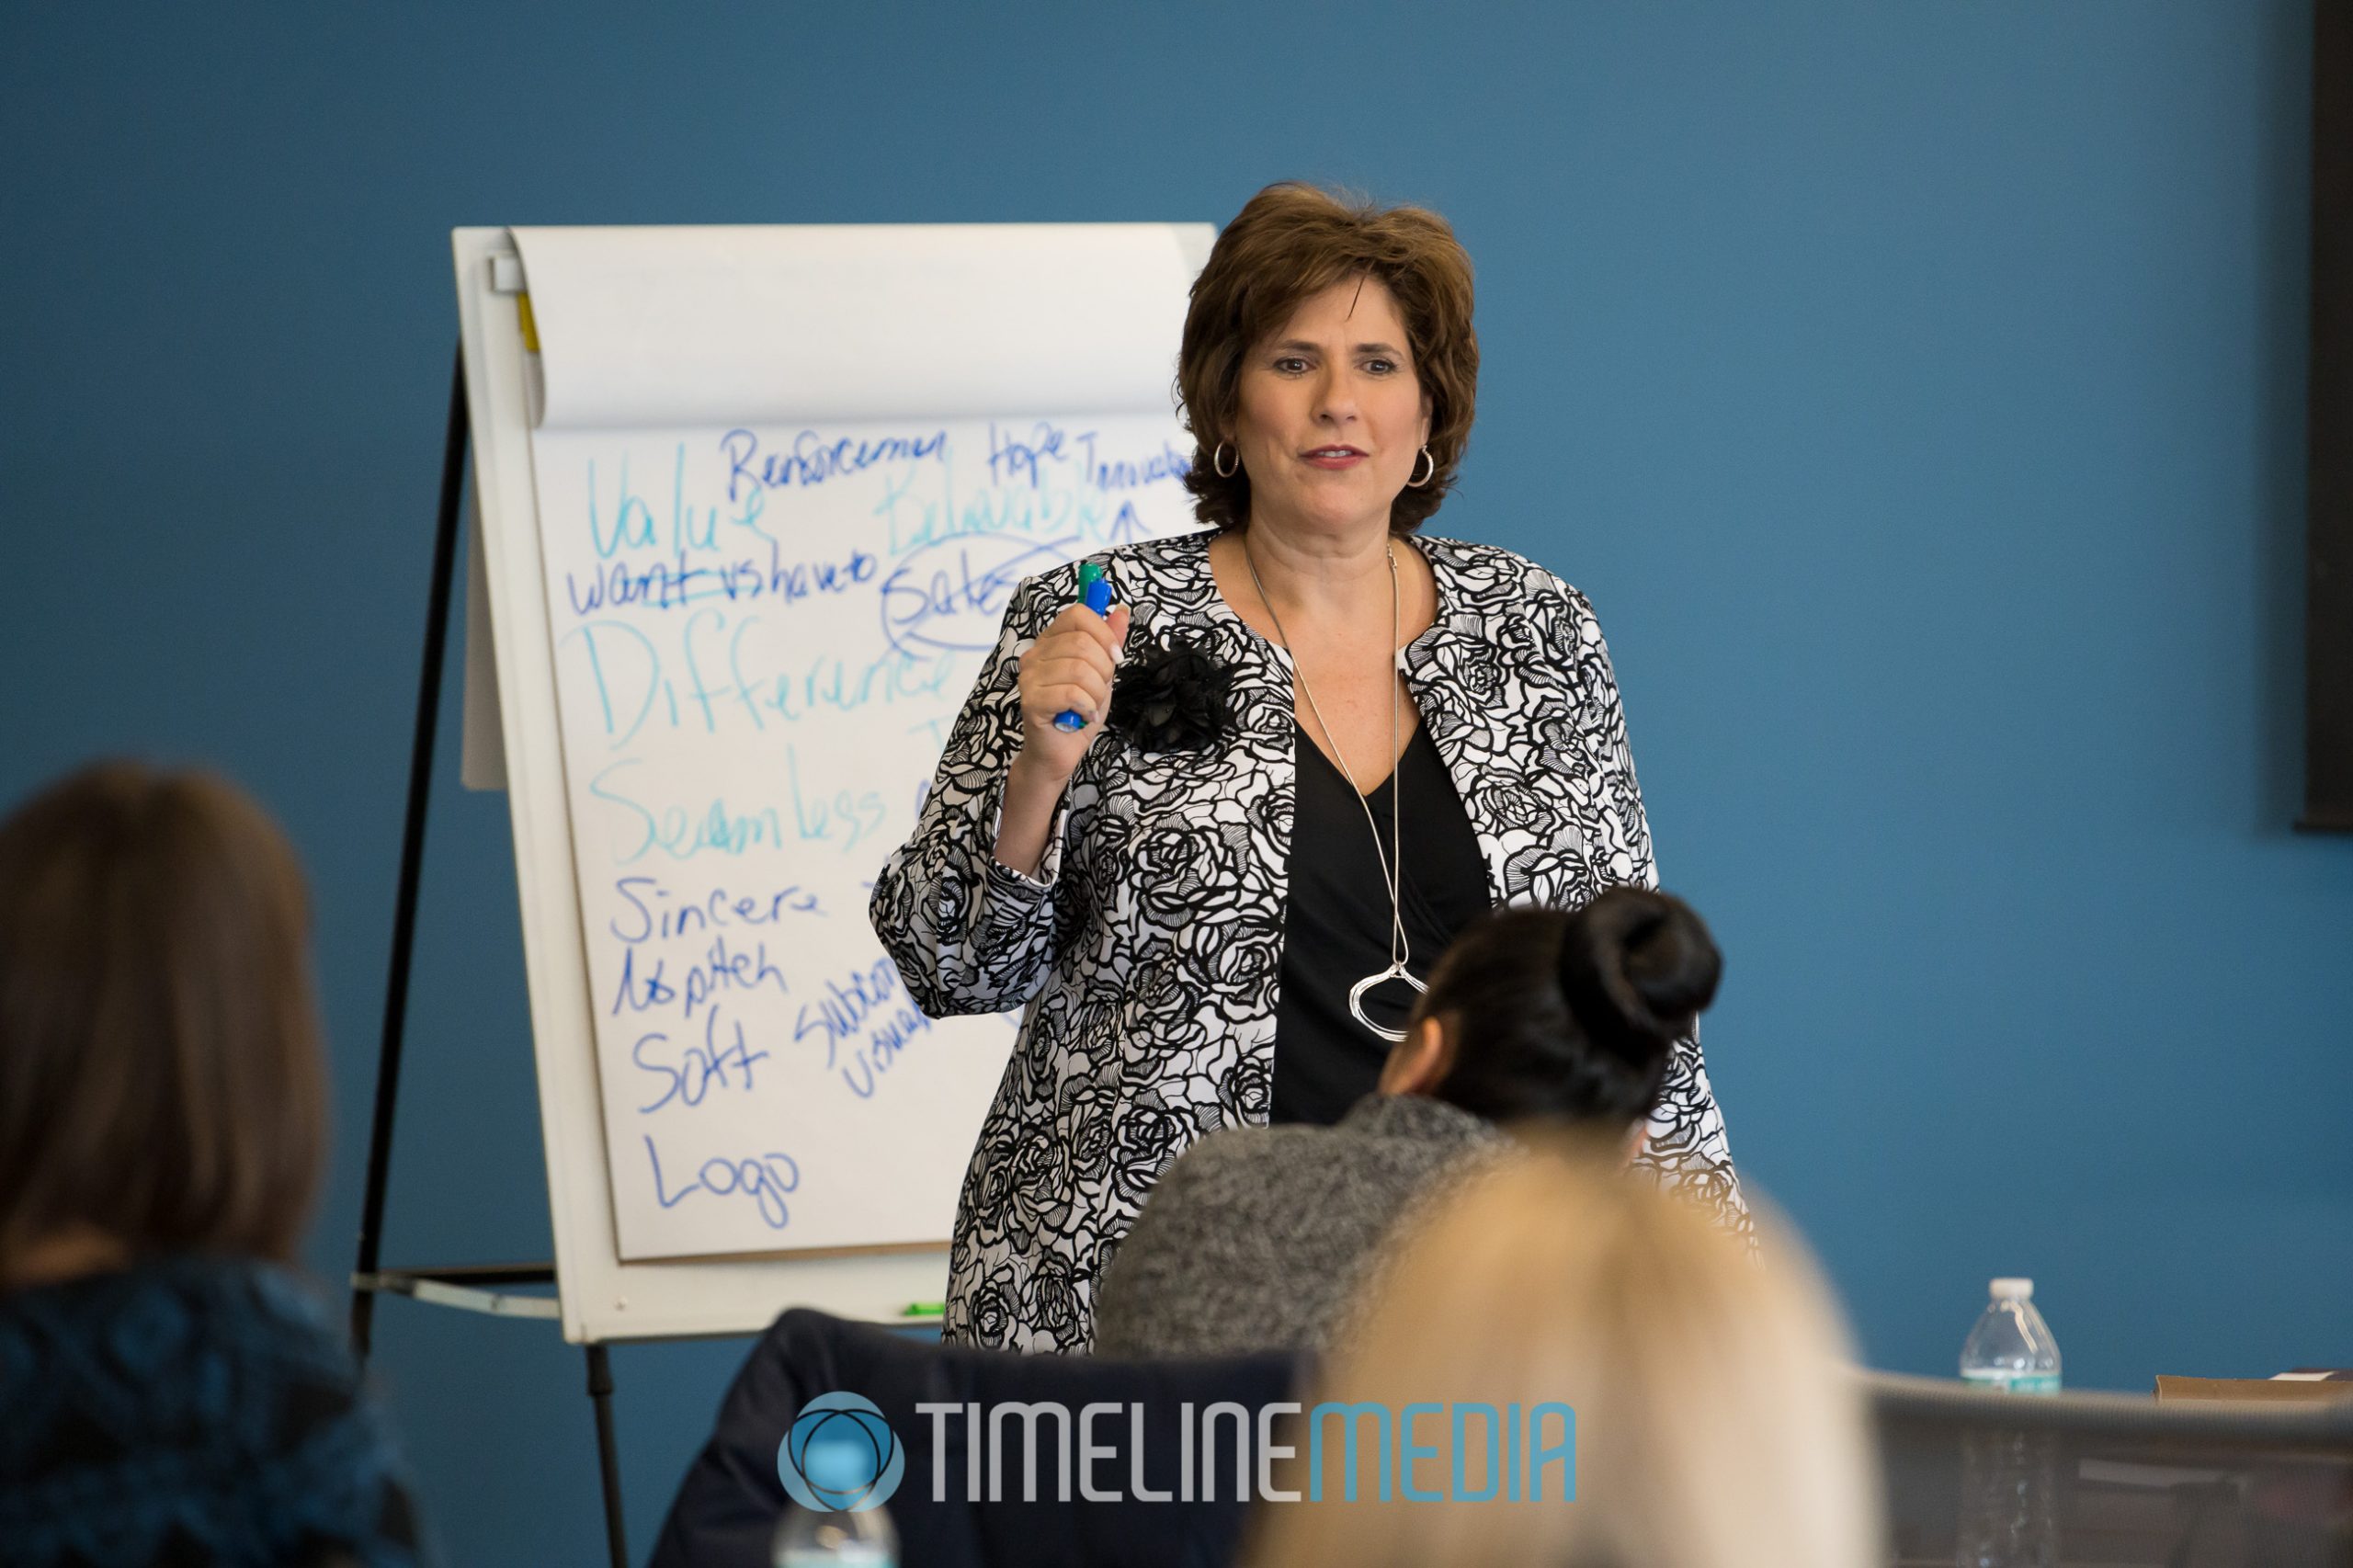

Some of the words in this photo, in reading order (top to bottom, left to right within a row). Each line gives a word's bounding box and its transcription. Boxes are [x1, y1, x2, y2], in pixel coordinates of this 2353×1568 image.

[588, 442, 774, 559] Value
[557, 608, 956, 751] Difference
[588, 743, 888, 867] Seamless
[631, 1004, 770, 1115] Soft
[642, 1133, 801, 1231] Logo
